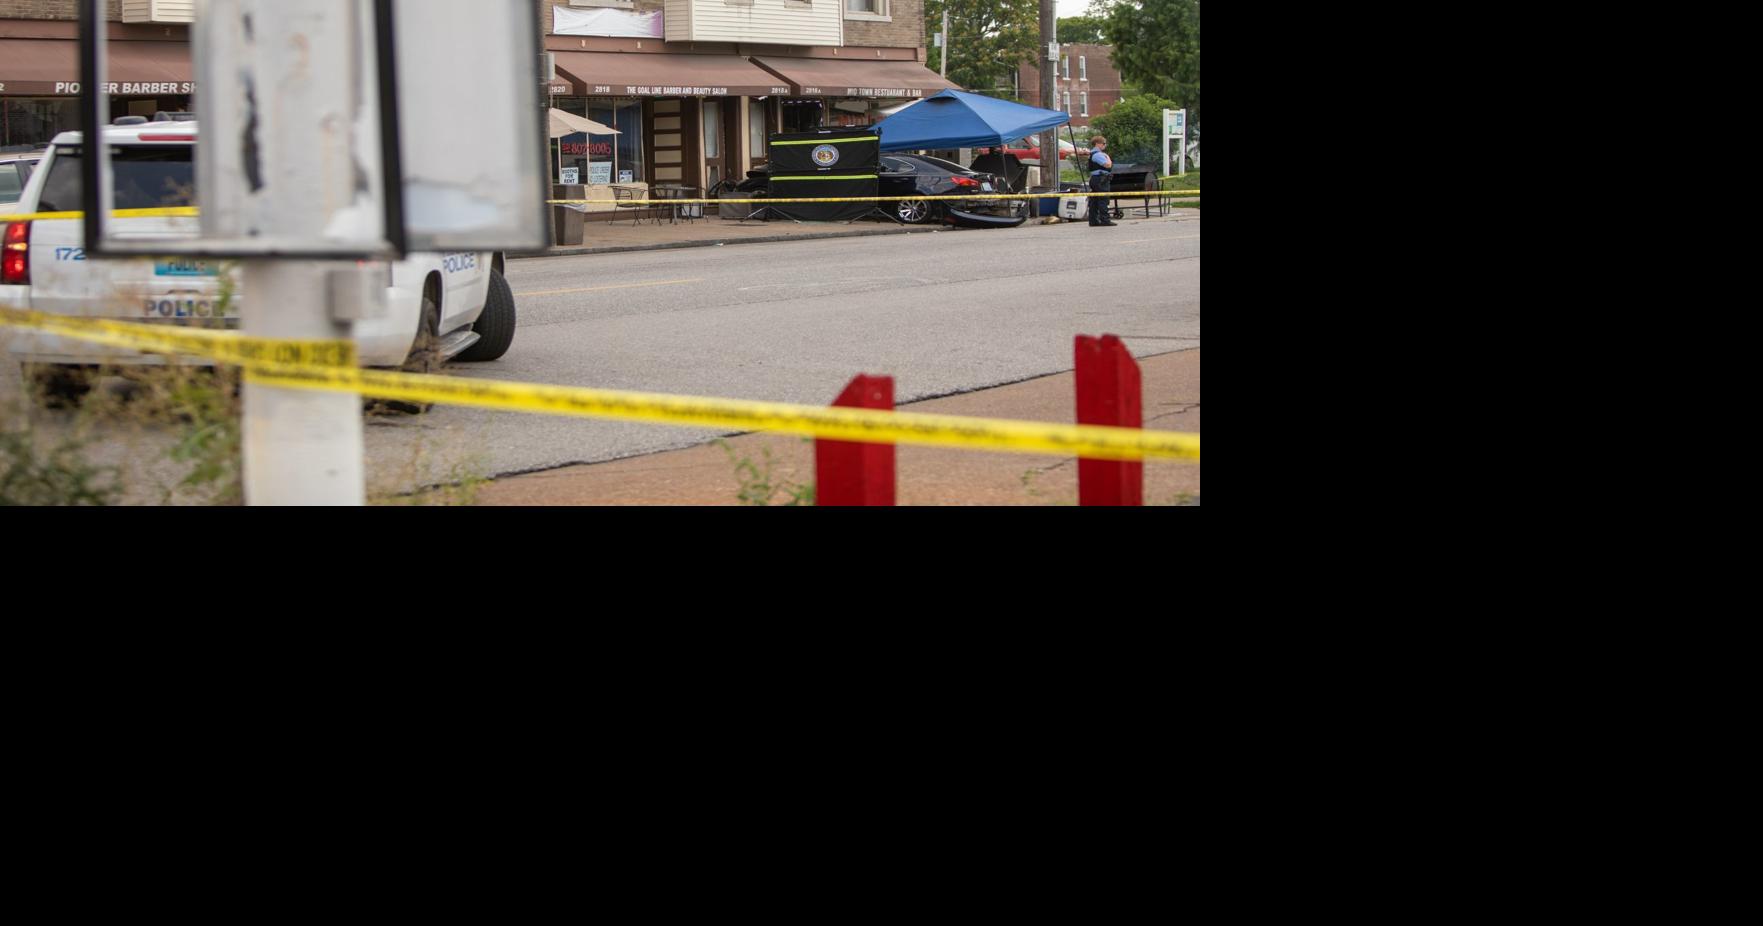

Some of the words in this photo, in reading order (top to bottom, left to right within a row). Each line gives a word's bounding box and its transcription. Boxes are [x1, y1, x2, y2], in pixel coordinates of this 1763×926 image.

[55, 82, 118, 94] PIOER
[122, 82, 178, 94] BARBER
[181, 82, 198, 94] SH
[626, 86, 636, 94] THE
[637, 86, 651, 94] GOAL
[651, 86, 662, 94] LINE
[663, 86, 682, 95] BARBER
[682, 87, 693, 95] AND
[693, 87, 712, 95] BEAUTY
[712, 87, 728, 95] SALON
[858, 88, 874, 96] TOWN
[912, 89, 922, 97] BAR
[443, 252, 475, 273] POLICE
